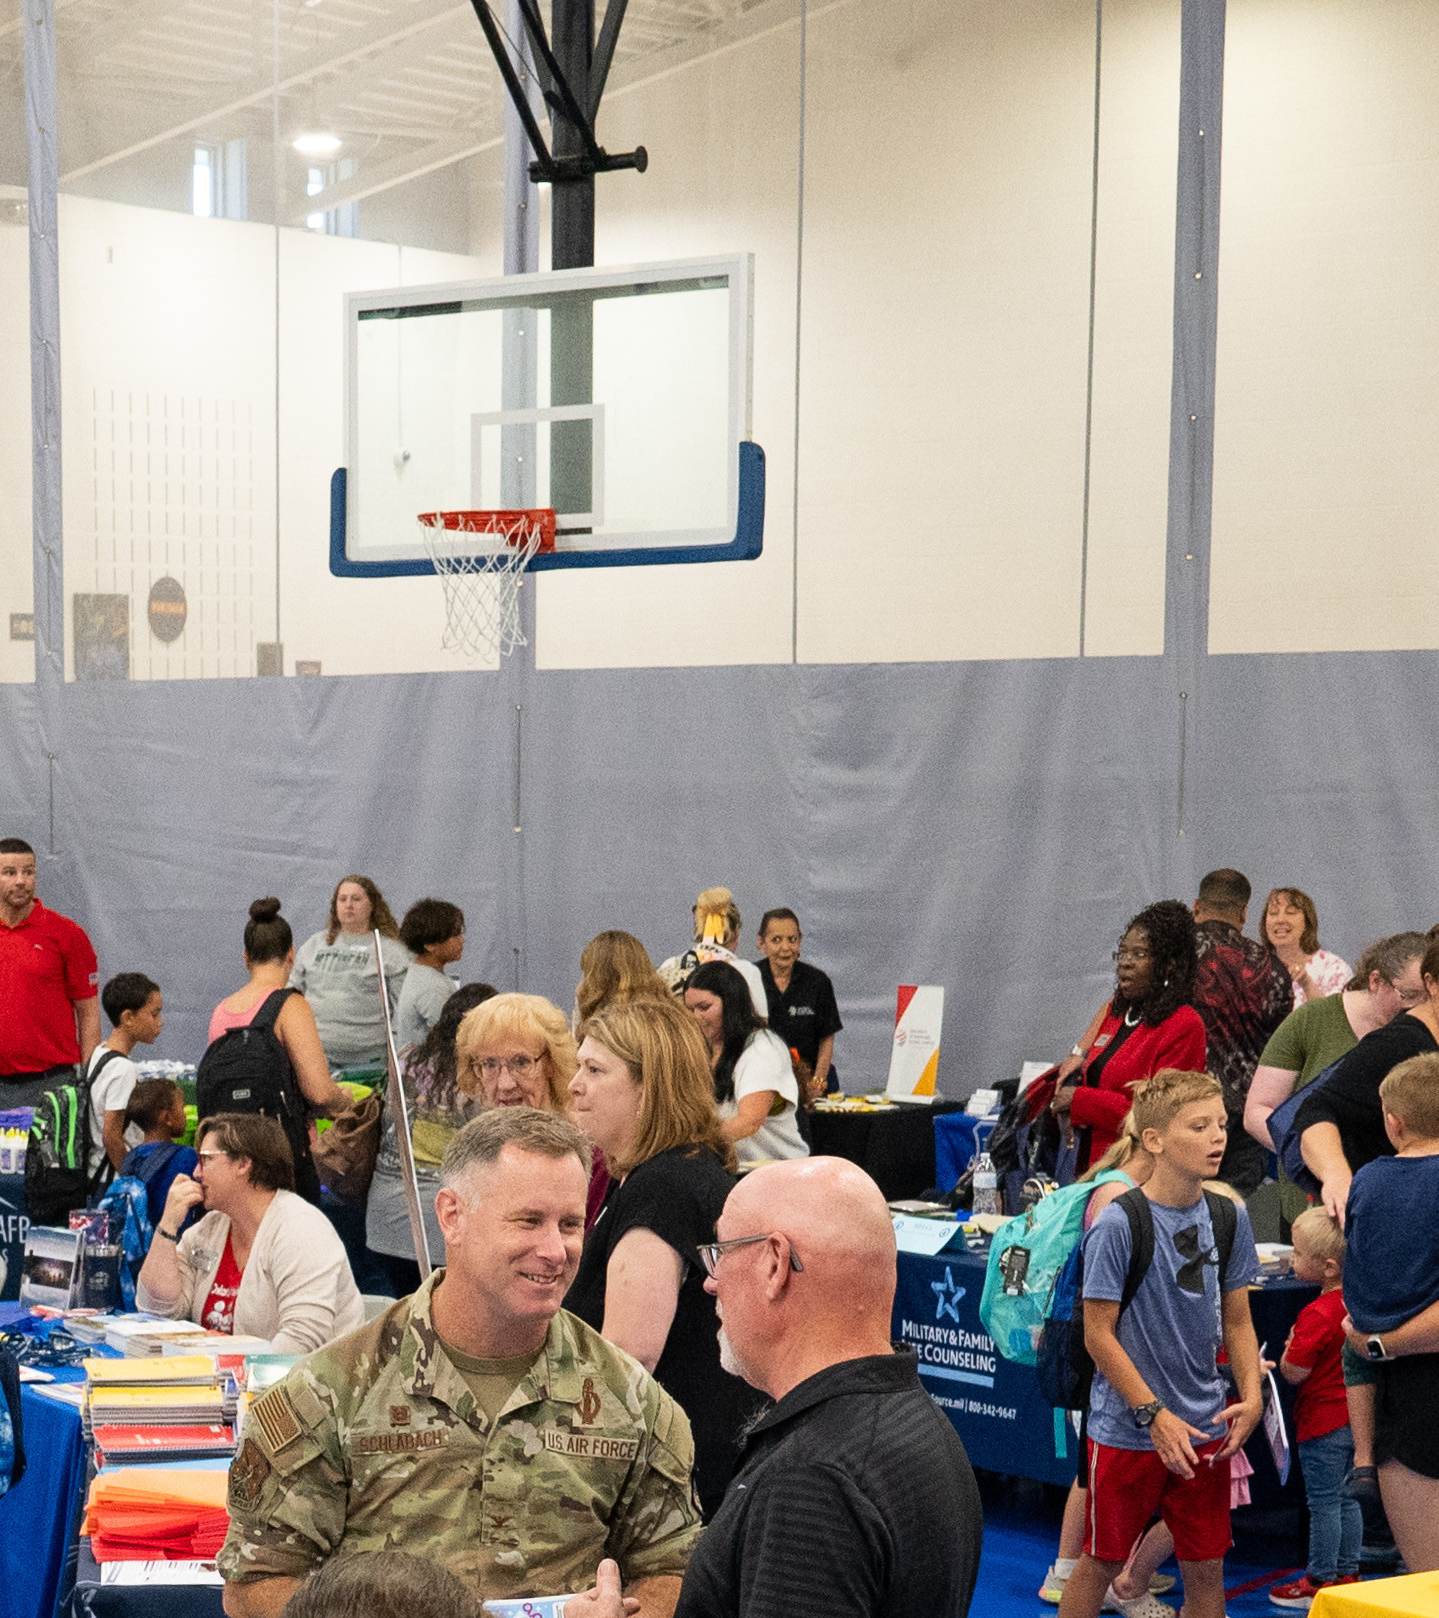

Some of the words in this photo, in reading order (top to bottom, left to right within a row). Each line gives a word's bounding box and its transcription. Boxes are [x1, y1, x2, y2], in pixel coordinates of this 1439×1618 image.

[924, 1344, 996, 1373] COUNSELING
[931, 1393, 964, 1410] Source.mil
[969, 1403, 1016, 1420] 800-342-9647
[359, 1429, 443, 1452] SCHLABACH
[548, 1432, 563, 1450] US
[566, 1436, 589, 1454] AIR
[593, 1439, 636, 1459] FORCE
